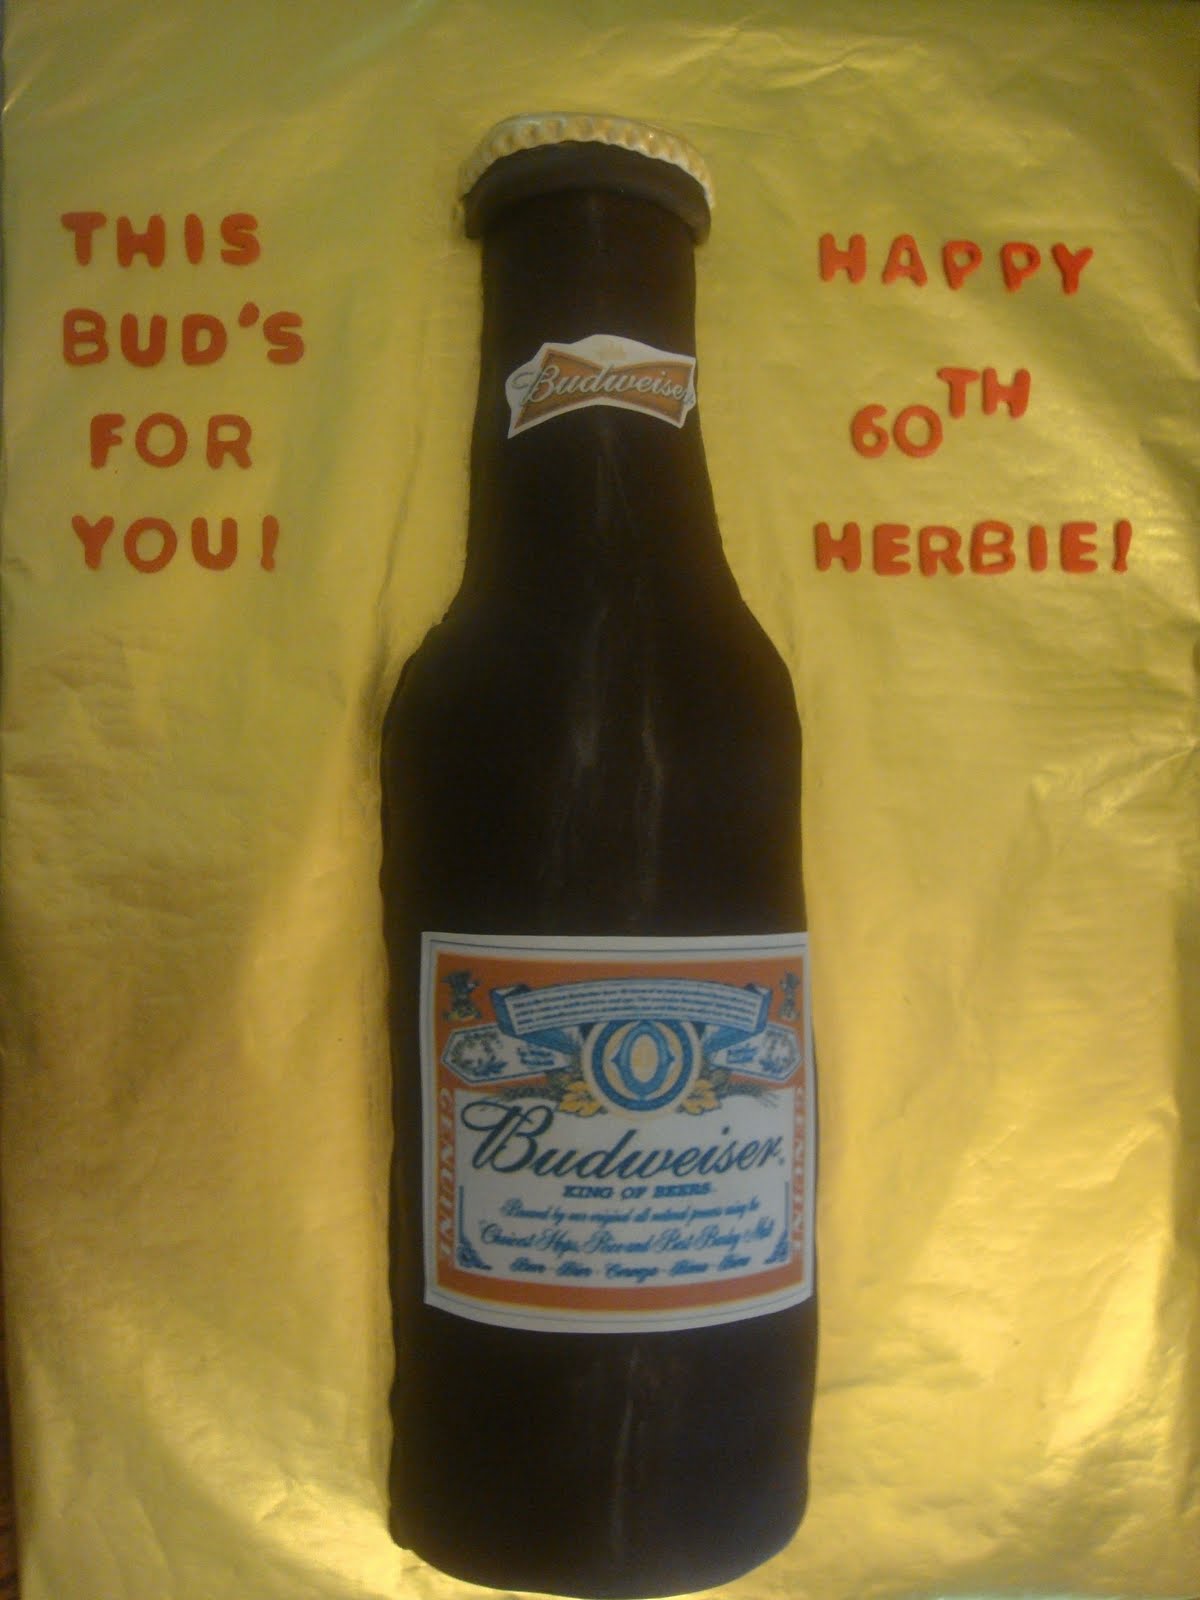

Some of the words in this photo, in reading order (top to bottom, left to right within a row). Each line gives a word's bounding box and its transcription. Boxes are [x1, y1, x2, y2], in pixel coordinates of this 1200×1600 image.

[61, 212, 261, 267] THIS
[819, 233, 1094, 295] HAPPY
[63, 302, 305, 367] BUD'S
[511, 362, 694, 405] Budweiser
[90, 412, 252, 469] FOR
[71, 514, 280, 573] YOU!
[814, 520, 1132, 577] HERBIE!
[460, 1099, 784, 1180] Budweiser
[563, 1184, 614, 1199] KING
[621, 1186, 648, 1201] OF
[652, 1182, 713, 1199] BEERS
